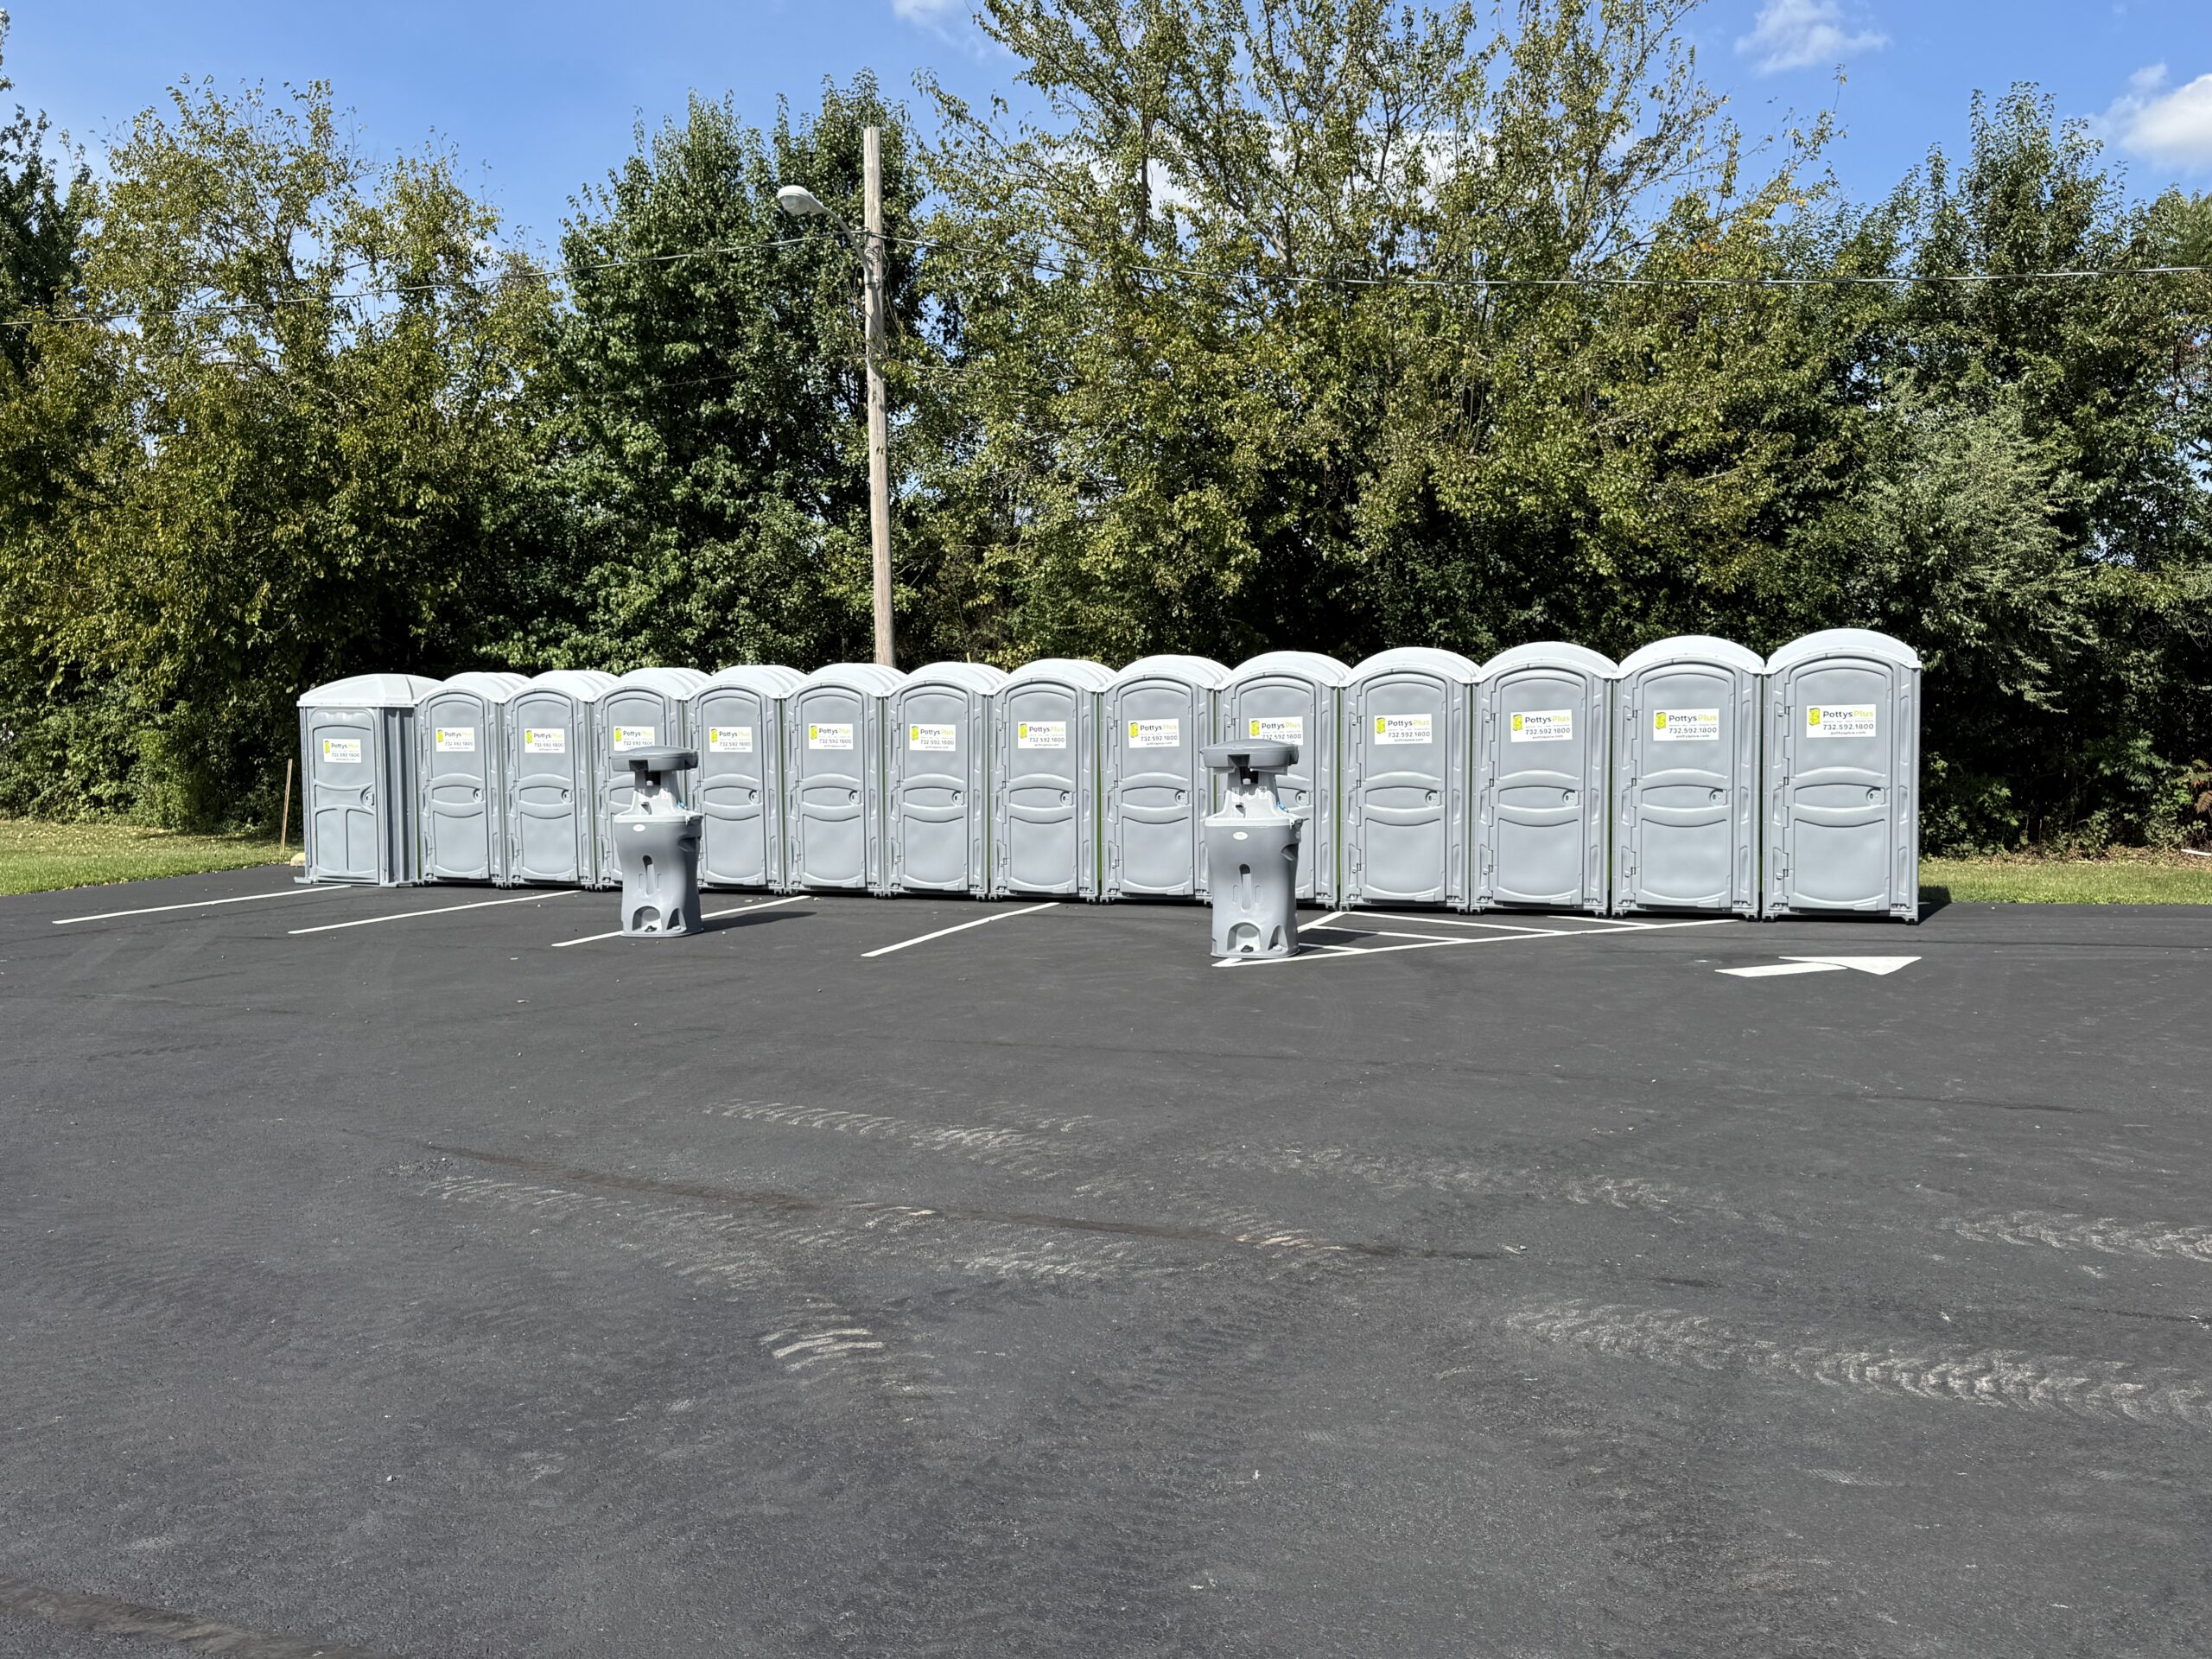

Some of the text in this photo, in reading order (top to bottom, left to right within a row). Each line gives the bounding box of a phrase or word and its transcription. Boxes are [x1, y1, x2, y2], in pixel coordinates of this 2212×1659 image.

[1669, 714, 1717, 723] PottysPlus
[1822, 709, 1873, 719] PottysPlus
[1387, 719, 1430, 728] PottysPlus
[1524, 715, 1570, 724] PottysPlus
[1262, 721, 1300, 730] PottysPlus
